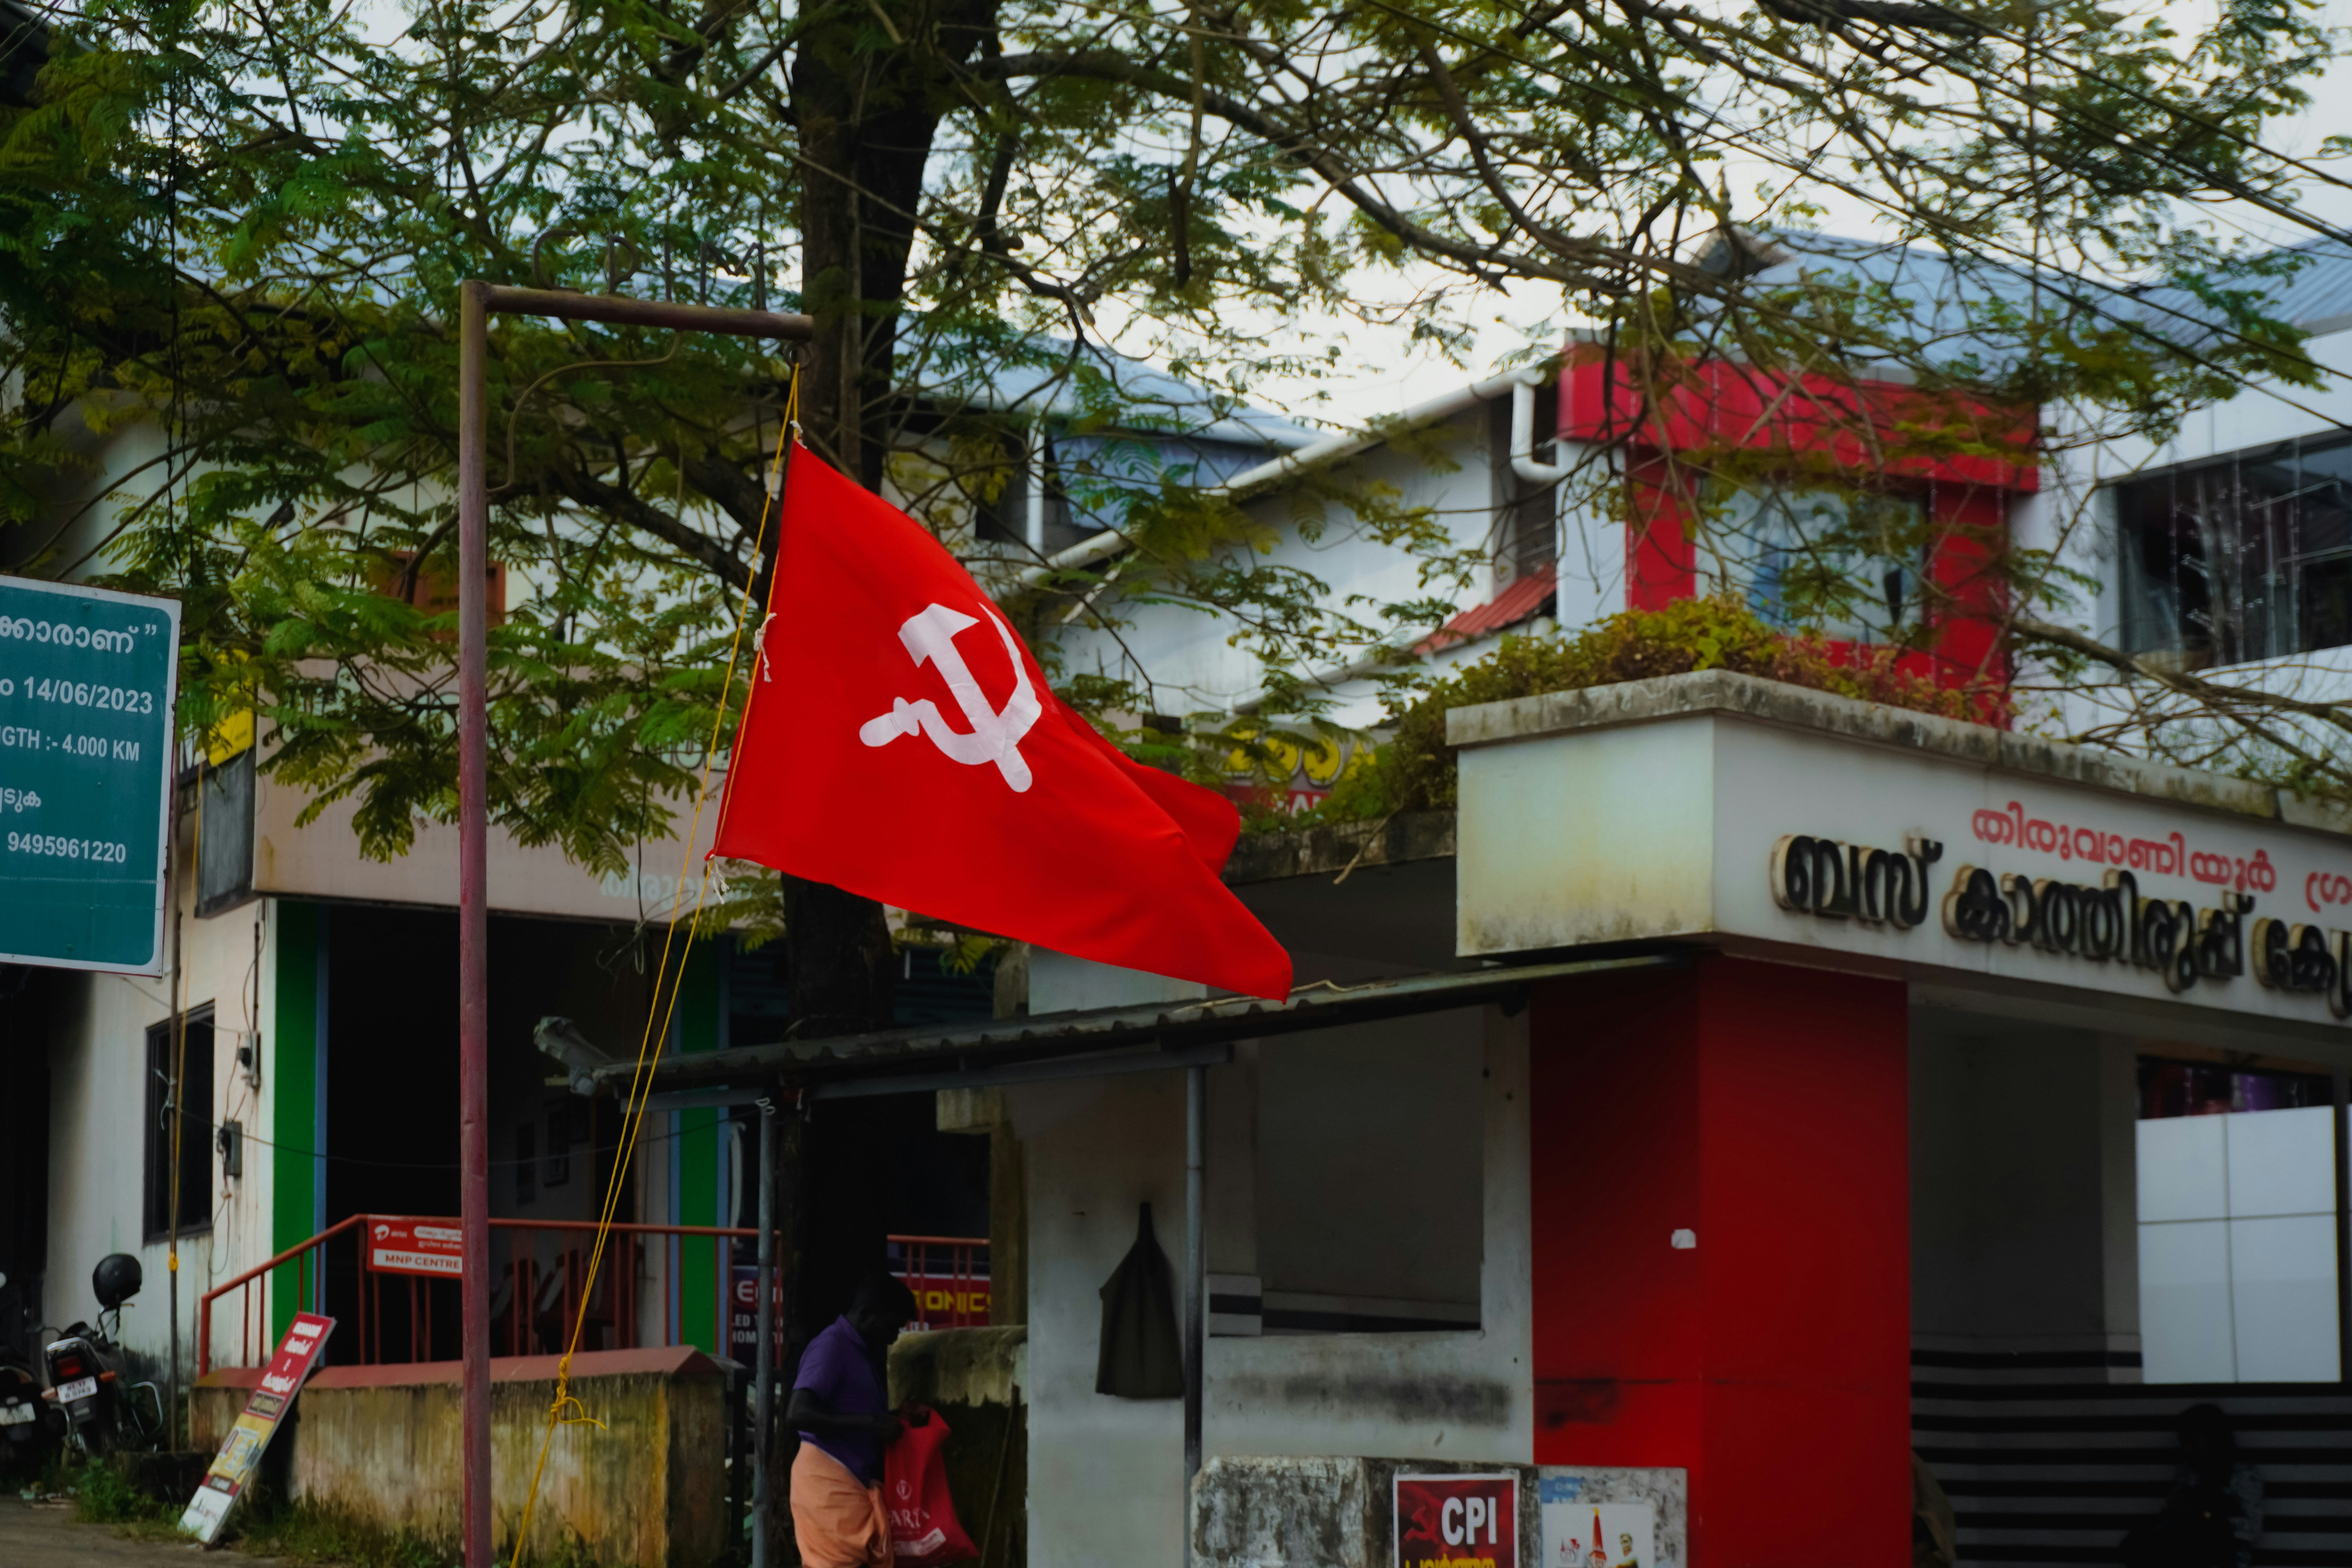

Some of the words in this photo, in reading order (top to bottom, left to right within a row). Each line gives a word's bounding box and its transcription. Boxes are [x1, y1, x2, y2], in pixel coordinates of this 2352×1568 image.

[24, 676, 152, 714] 14/06/2023
[0, 725, 40, 750] GTH
[113, 740, 140, 761] KM
[8, 831, 126, 863] 9495961220
[385, 1254, 412, 1264] MNP
[414, 1257, 460, 1269] CENTRE
[1441, 1496, 1497, 1546] CPI
